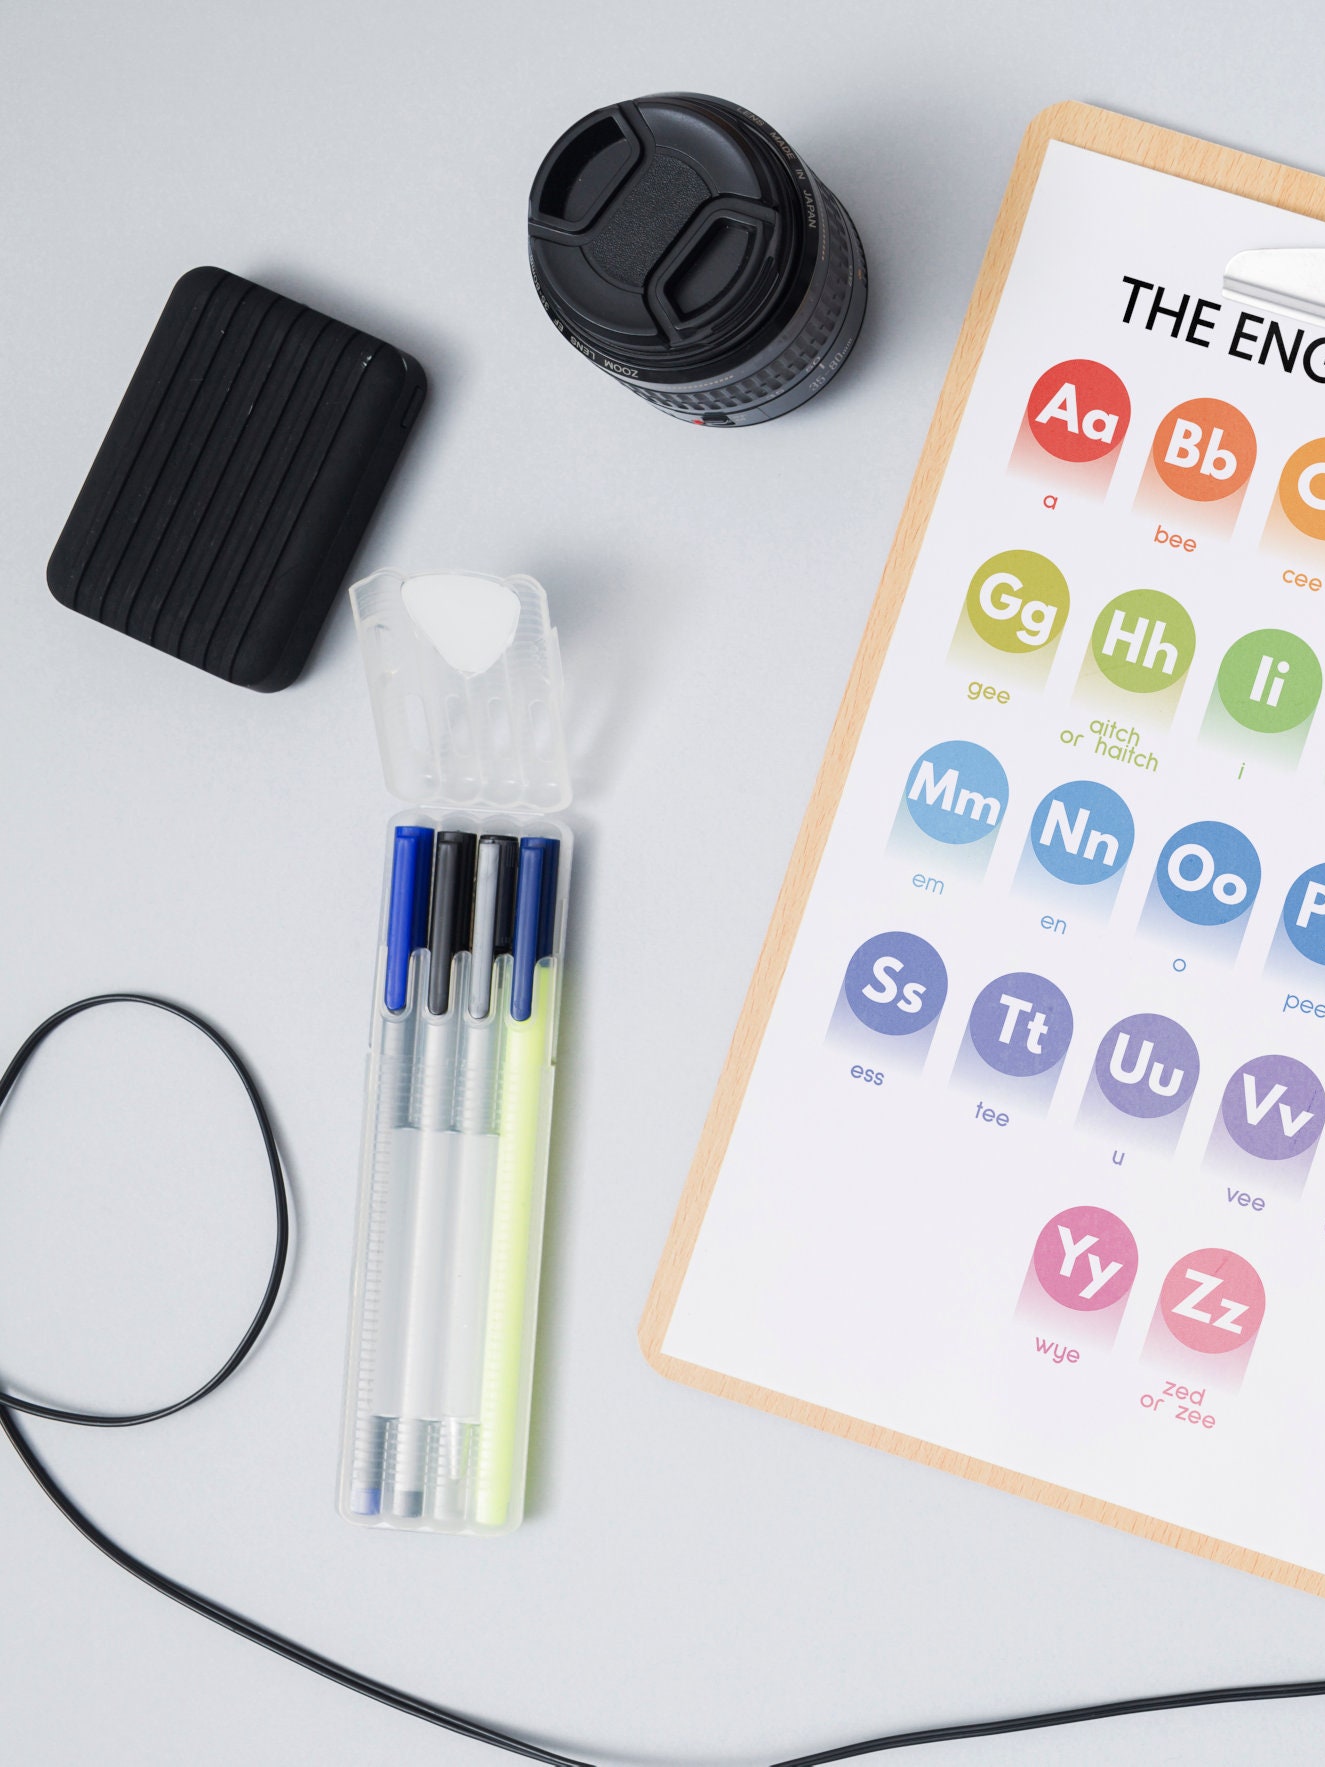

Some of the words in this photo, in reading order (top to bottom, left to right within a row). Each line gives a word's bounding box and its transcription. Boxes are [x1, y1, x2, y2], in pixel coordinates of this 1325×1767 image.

[737, 107, 765, 127] LENS
[769, 131, 796, 160] MADE
[796, 168, 806, 180] IN
[803, 189, 817, 229] JAPAN
[1122, 275, 1223, 349] THE
[554, 319, 564, 332] EF
[570, 335, 596, 360] LENS
[604, 359, 639, 378] ZOOM
[1035, 382, 1119, 444] Aa
[1164, 418, 1237, 480] Bb
[1042, 494, 1059, 511] a
[1153, 524, 1197, 553] bee
[1281, 569, 1323, 593] cee
[979, 572, 1057, 646] Gg
[1102, 609, 1178, 675] Hh
[1249, 655, 1290, 707] Ii
[967, 681, 1011, 705] gee
[1089, 719, 1140, 747] aitch
[1059, 729, 1085, 747] or
[1094, 735, 1159, 773] haitch
[1236, 761, 1247, 781] i
[908, 760, 1001, 826] Mm
[1039, 799, 1119, 866] Nn
[1167, 843, 1247, 905] Oo
[912, 873, 945, 895] em
[1040, 915, 1067, 935] en
[1172, 958, 1187, 973] o
[862, 956, 926, 1013] Ss
[998, 993, 1049, 1054] Tt
[1109, 1032, 1185, 1097] Uu
[1243, 1073, 1314, 1138] Vv
[850, 1064, 885, 1086] ess
[975, 1101, 1010, 1127] tee
[1112, 1150, 1125, 1166] u
[1227, 1187, 1266, 1212] vee
[1057, 1225, 1123, 1299] Yy
[1171, 1268, 1250, 1335] Zz
[1035, 1336, 1080, 1364] wye
[1162, 1380, 1206, 1407] zed
[1140, 1394, 1165, 1411] or
[1175, 1405, 1216, 1429] zee
